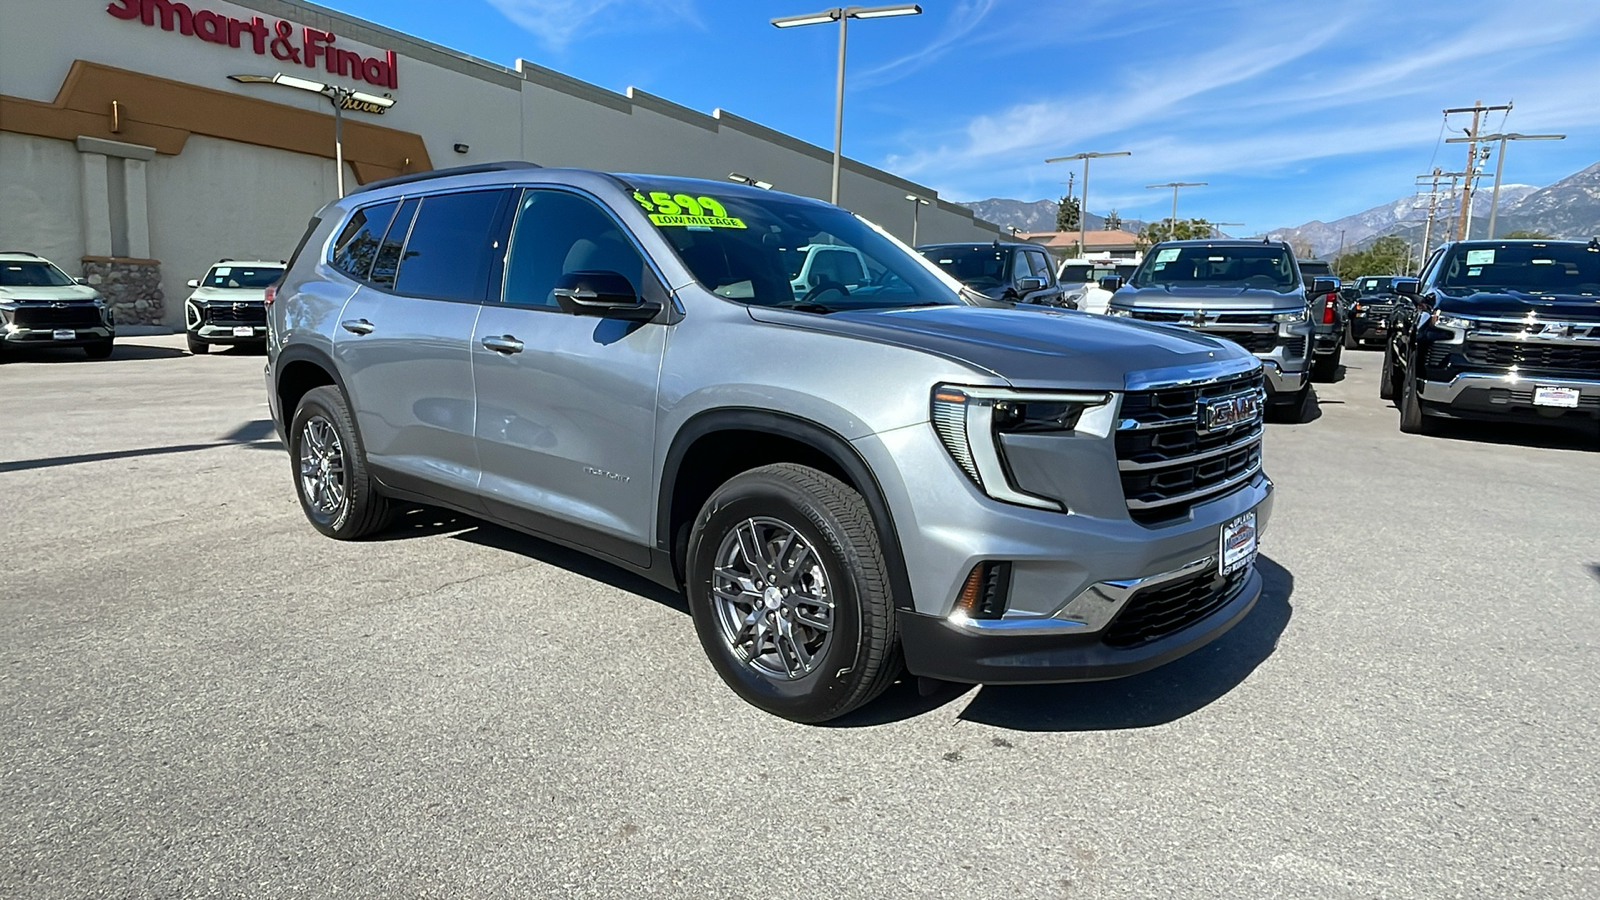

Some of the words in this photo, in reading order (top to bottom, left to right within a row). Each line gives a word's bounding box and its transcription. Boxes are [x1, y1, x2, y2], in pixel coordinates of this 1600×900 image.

[633, 188, 728, 218] $599
[656, 215, 683, 225] LOW
[686, 215, 738, 226] MILEAGE
[1211, 395, 1258, 426] GMC
